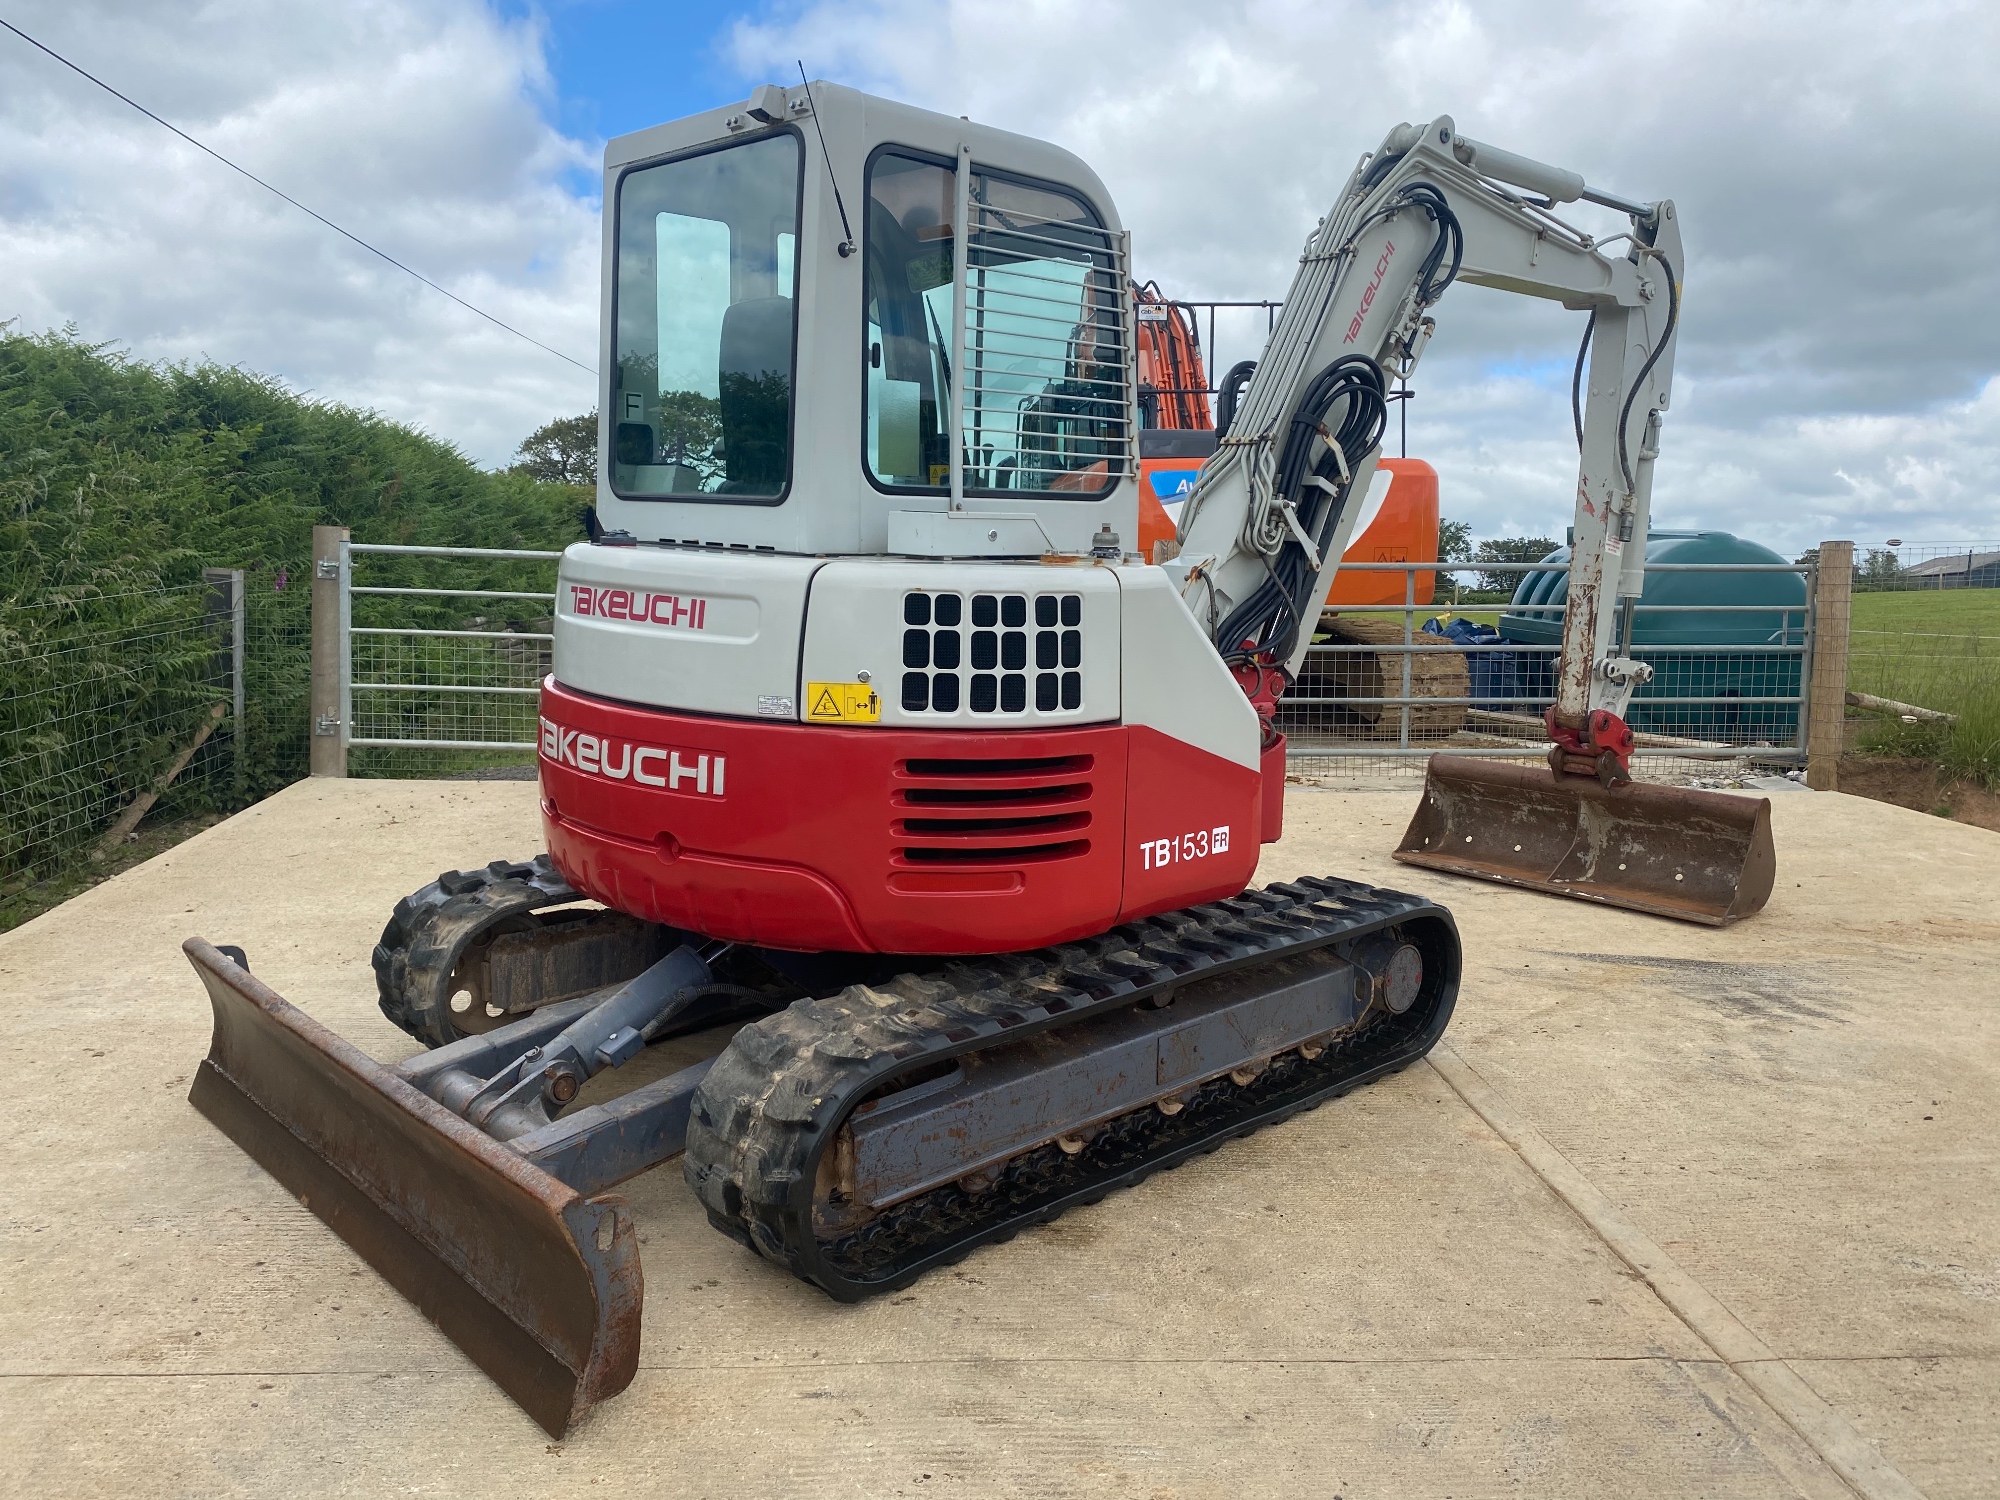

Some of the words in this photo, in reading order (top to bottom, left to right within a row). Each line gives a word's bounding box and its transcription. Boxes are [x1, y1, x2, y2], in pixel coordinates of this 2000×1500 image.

[1342, 240, 1396, 345] TAKEUCHI
[626, 392, 642, 419] F
[570, 585, 706, 630] TAKEUCHI
[539, 715, 726, 796] TAKEUCHI
[1139, 830, 1209, 871] TB153
